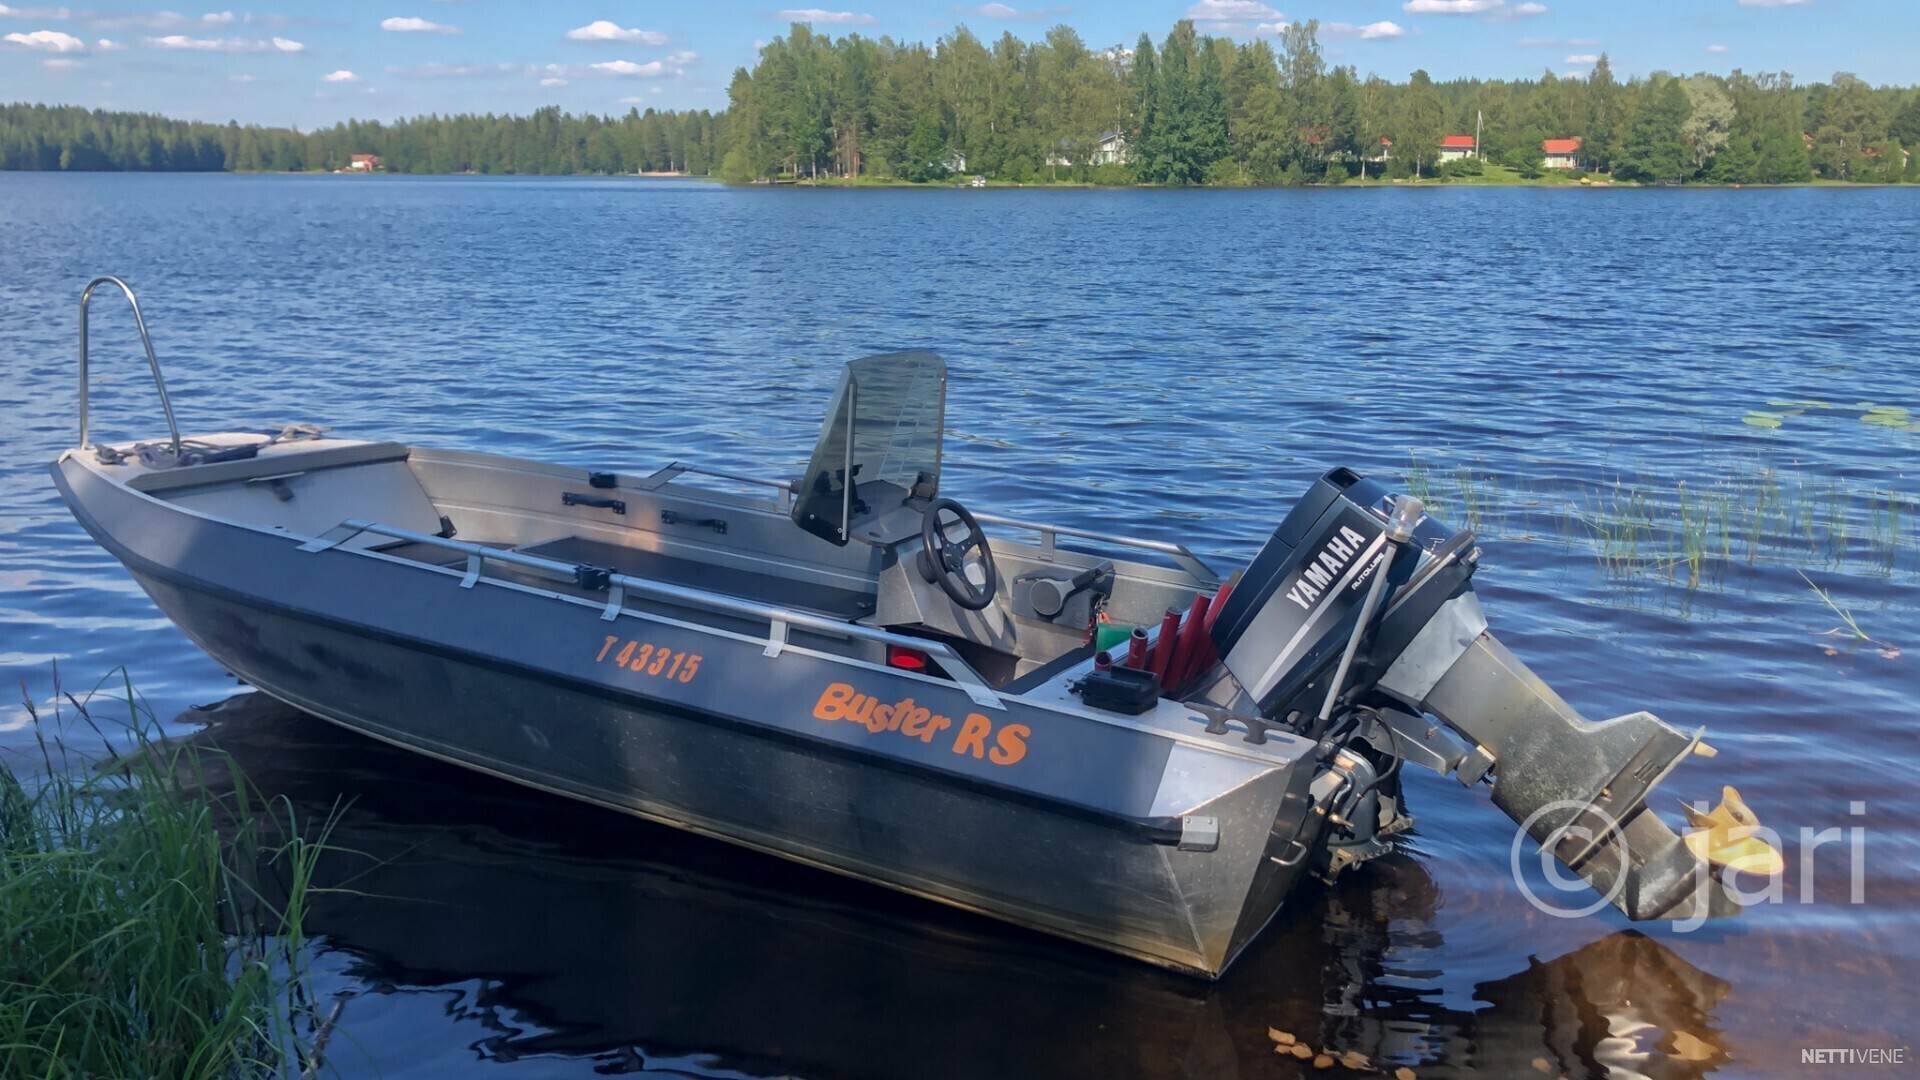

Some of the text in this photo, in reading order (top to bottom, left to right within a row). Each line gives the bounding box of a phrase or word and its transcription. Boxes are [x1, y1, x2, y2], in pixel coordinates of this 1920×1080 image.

[1286, 525, 1366, 610] YAMAHA
[1351, 552, 1385, 591] AUTOLUBE
[596, 636, 703, 683] T 43315
[813, 683, 1032, 765] Buster RS
